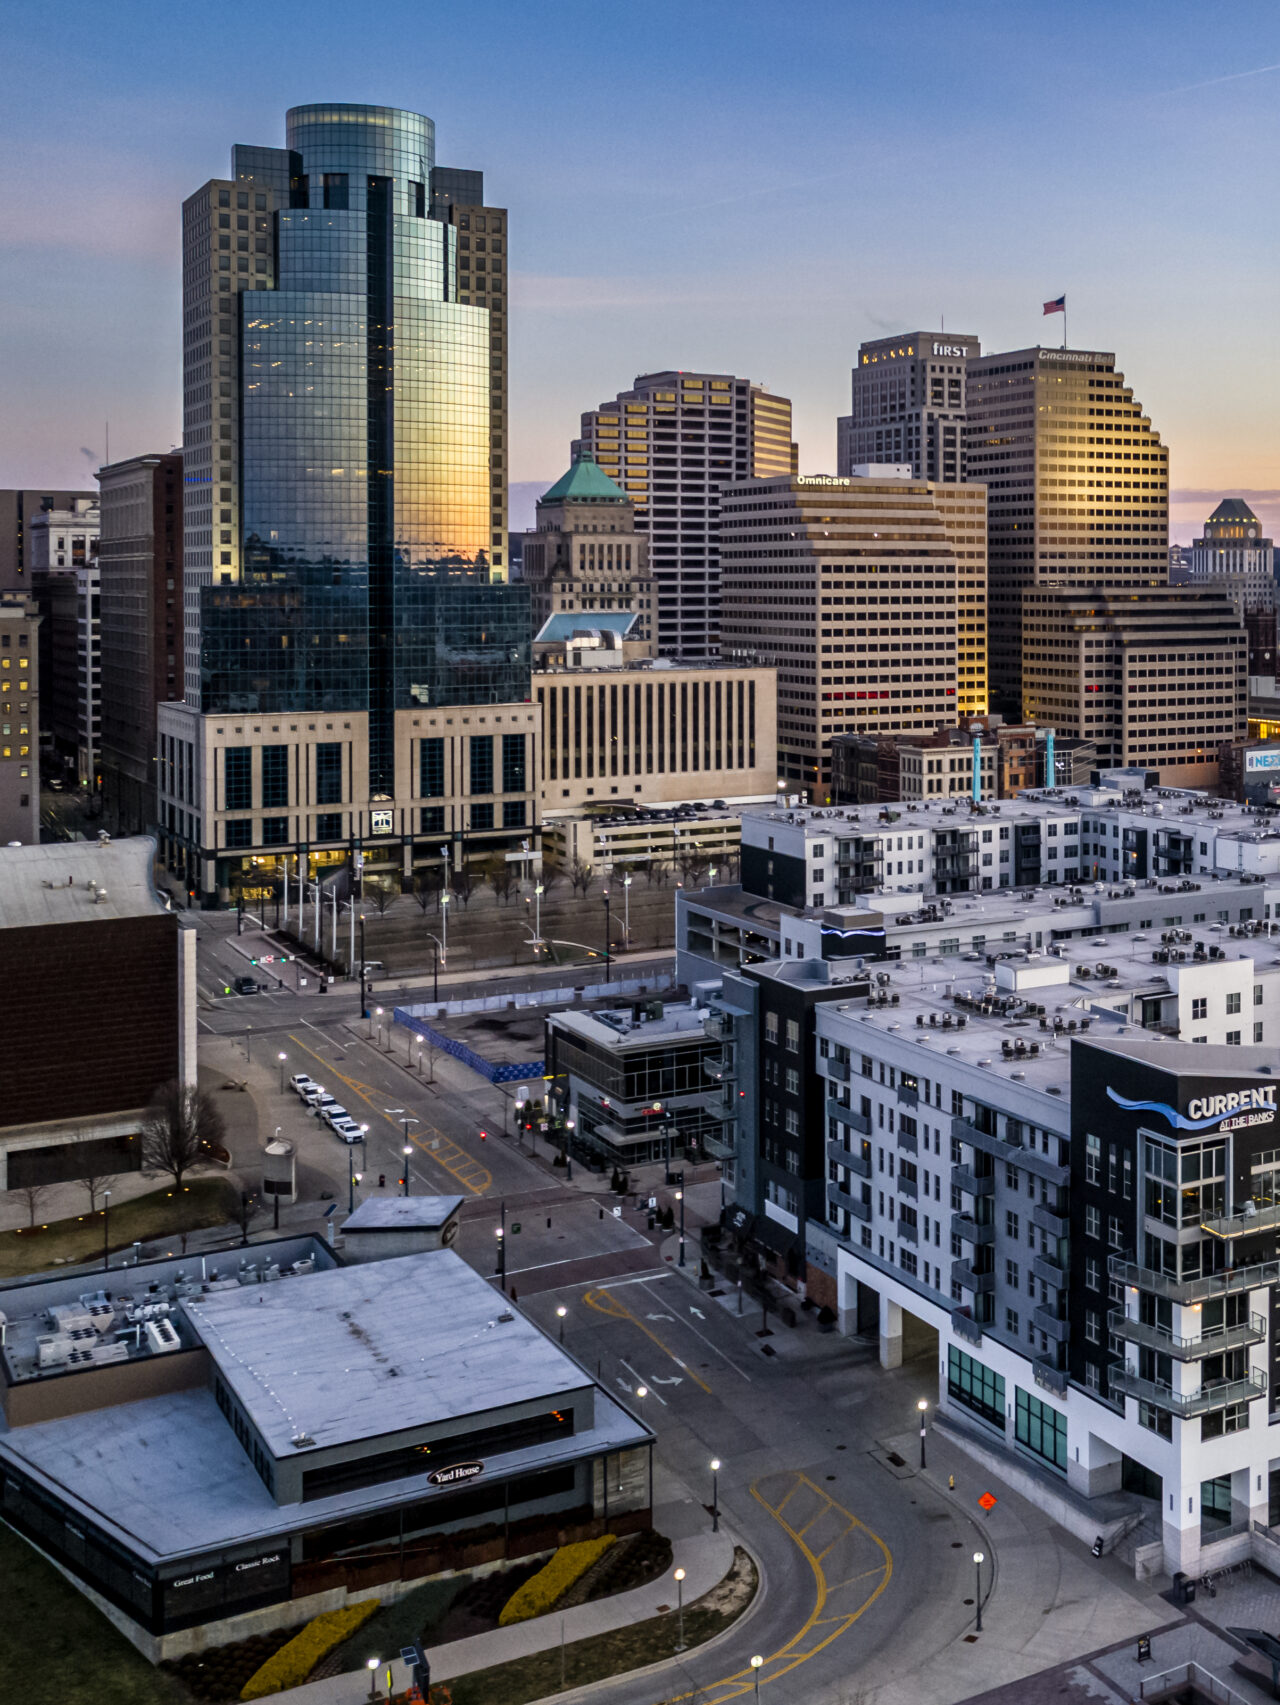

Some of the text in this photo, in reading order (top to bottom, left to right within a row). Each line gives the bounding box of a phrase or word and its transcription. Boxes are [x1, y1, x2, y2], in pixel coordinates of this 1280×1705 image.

[1038, 350, 1092, 363] Cincinnati
[797, 475, 851, 486] Omnicare
[1188, 1085, 1277, 1120] CURRENT
[1219, 1110, 1276, 1132] AT THE BANKS
[436, 1466, 481, 1483] Yard House
[173, 1571, 215, 1588] Great Food
